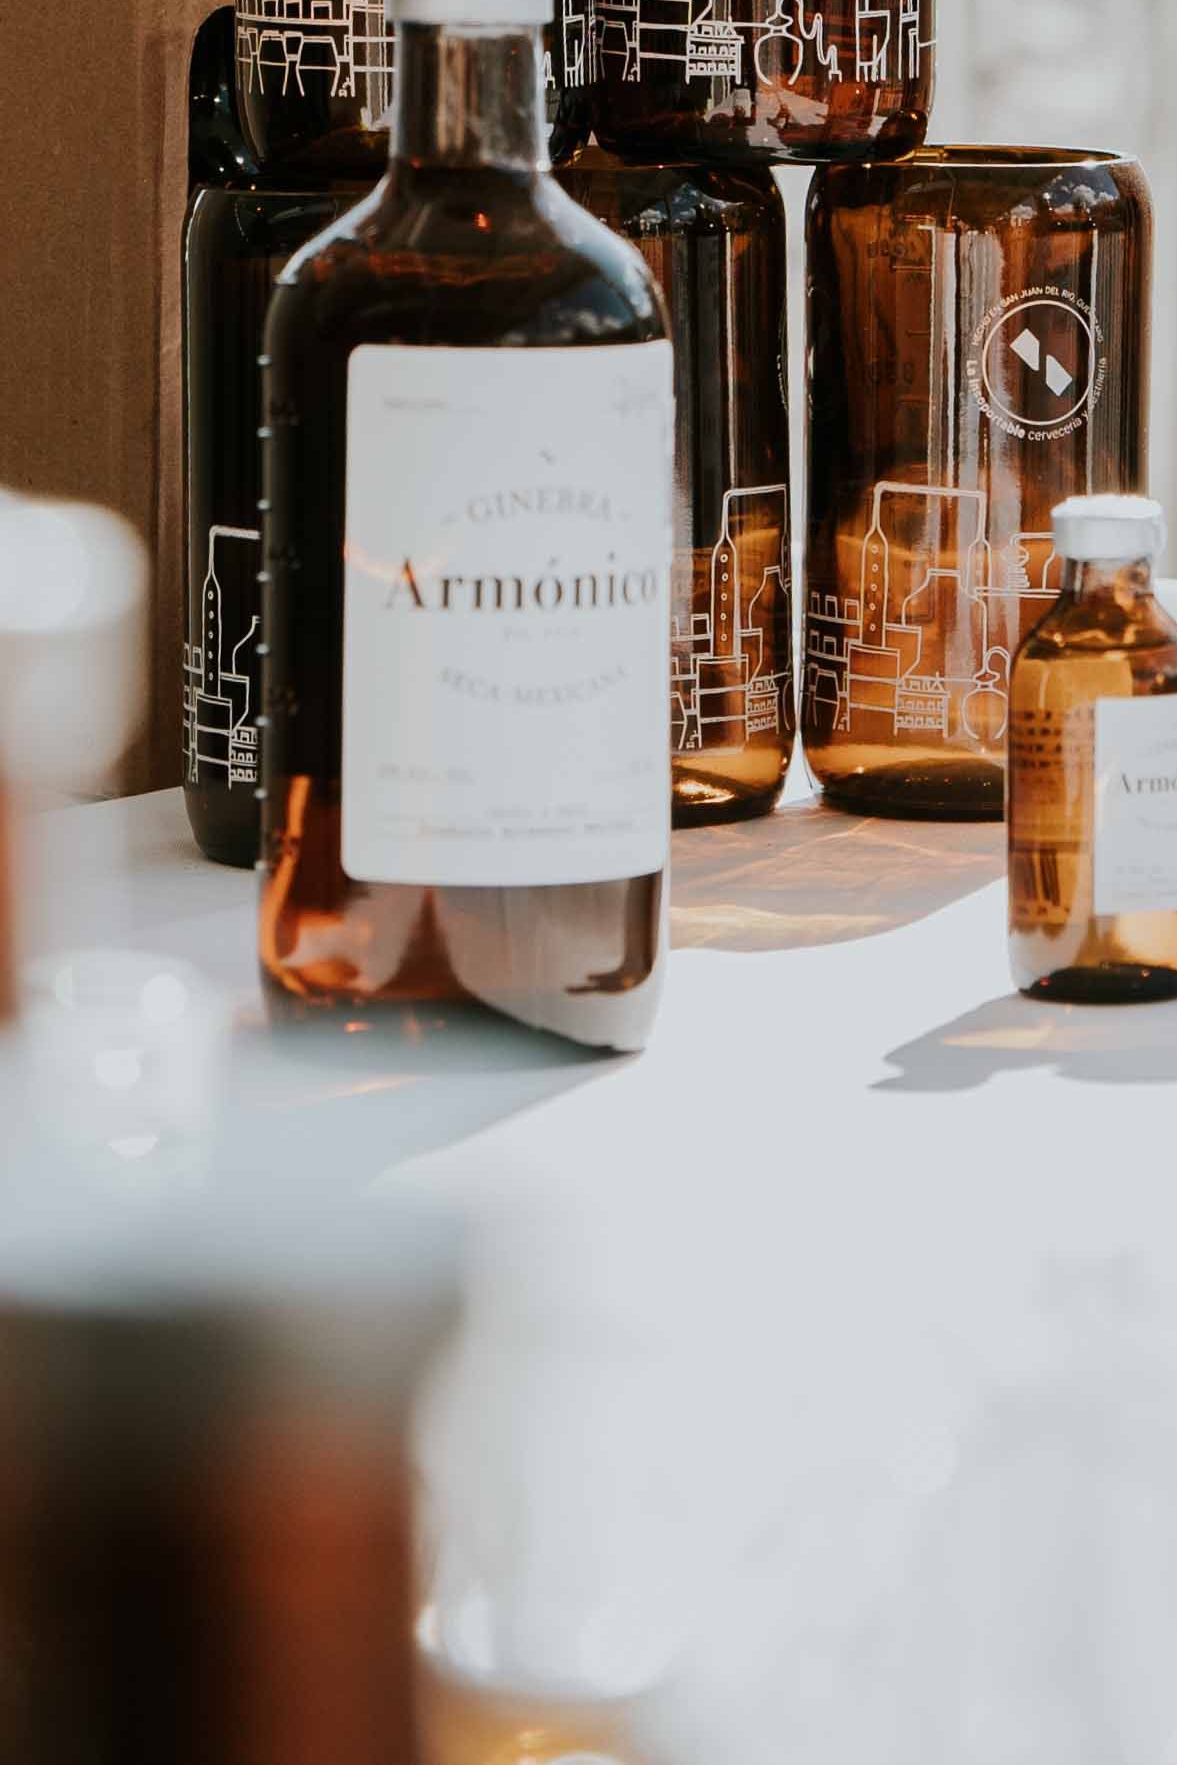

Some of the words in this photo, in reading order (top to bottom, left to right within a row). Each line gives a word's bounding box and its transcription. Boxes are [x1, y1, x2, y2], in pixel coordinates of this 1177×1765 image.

[1000, 291, 1020, 309] SAN
[1020, 286, 1044, 300] JUAN
[1044, 285, 1060, 297] DEL
[965, 359, 979, 377] La
[385, 551, 657, 610] Armónico
